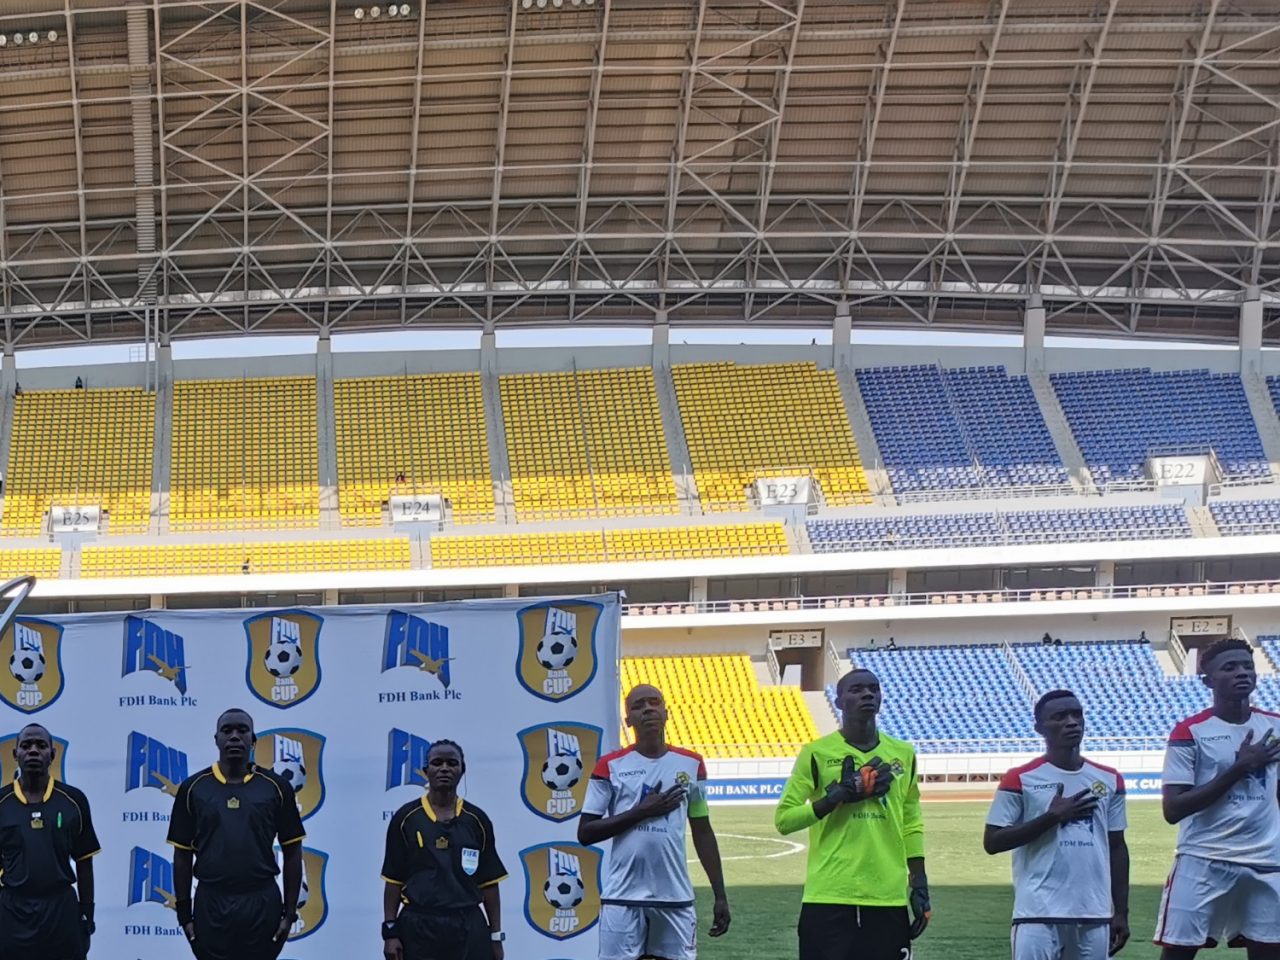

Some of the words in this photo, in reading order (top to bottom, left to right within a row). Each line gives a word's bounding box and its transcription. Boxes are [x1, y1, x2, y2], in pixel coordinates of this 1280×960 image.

[1160, 462, 1195, 480] E22
[766, 483, 798, 499] E23
[401, 501, 430, 516] E24
[62, 511, 91, 526] E25
[1191, 620, 1210, 632] E2
[788, 633, 806, 646] E3
[122, 614, 187, 697] FDH
[381, 609, 450, 690] FDH
[271, 685, 299, 701] CUP
[543, 678, 572, 695] CUP
[16, 691, 43, 707] CUP
[119, 696, 146, 707] FDH
[149, 695, 178, 706] Bank
[181, 695, 198, 706] Plc
[378, 692, 406, 703] FDH
[409, 691, 439, 702] Bank
[443, 690, 462, 700] Plc
[727, 784, 758, 795] BANK
[761, 783, 783, 793] PLC
[547, 799, 576, 815] CUP
[123, 812, 148, 822] FDH
[463, 850, 477, 858] FIFA
[125, 925, 151, 937] FDH
[154, 925, 183, 937] Bank
[550, 917, 579, 934] CUP
